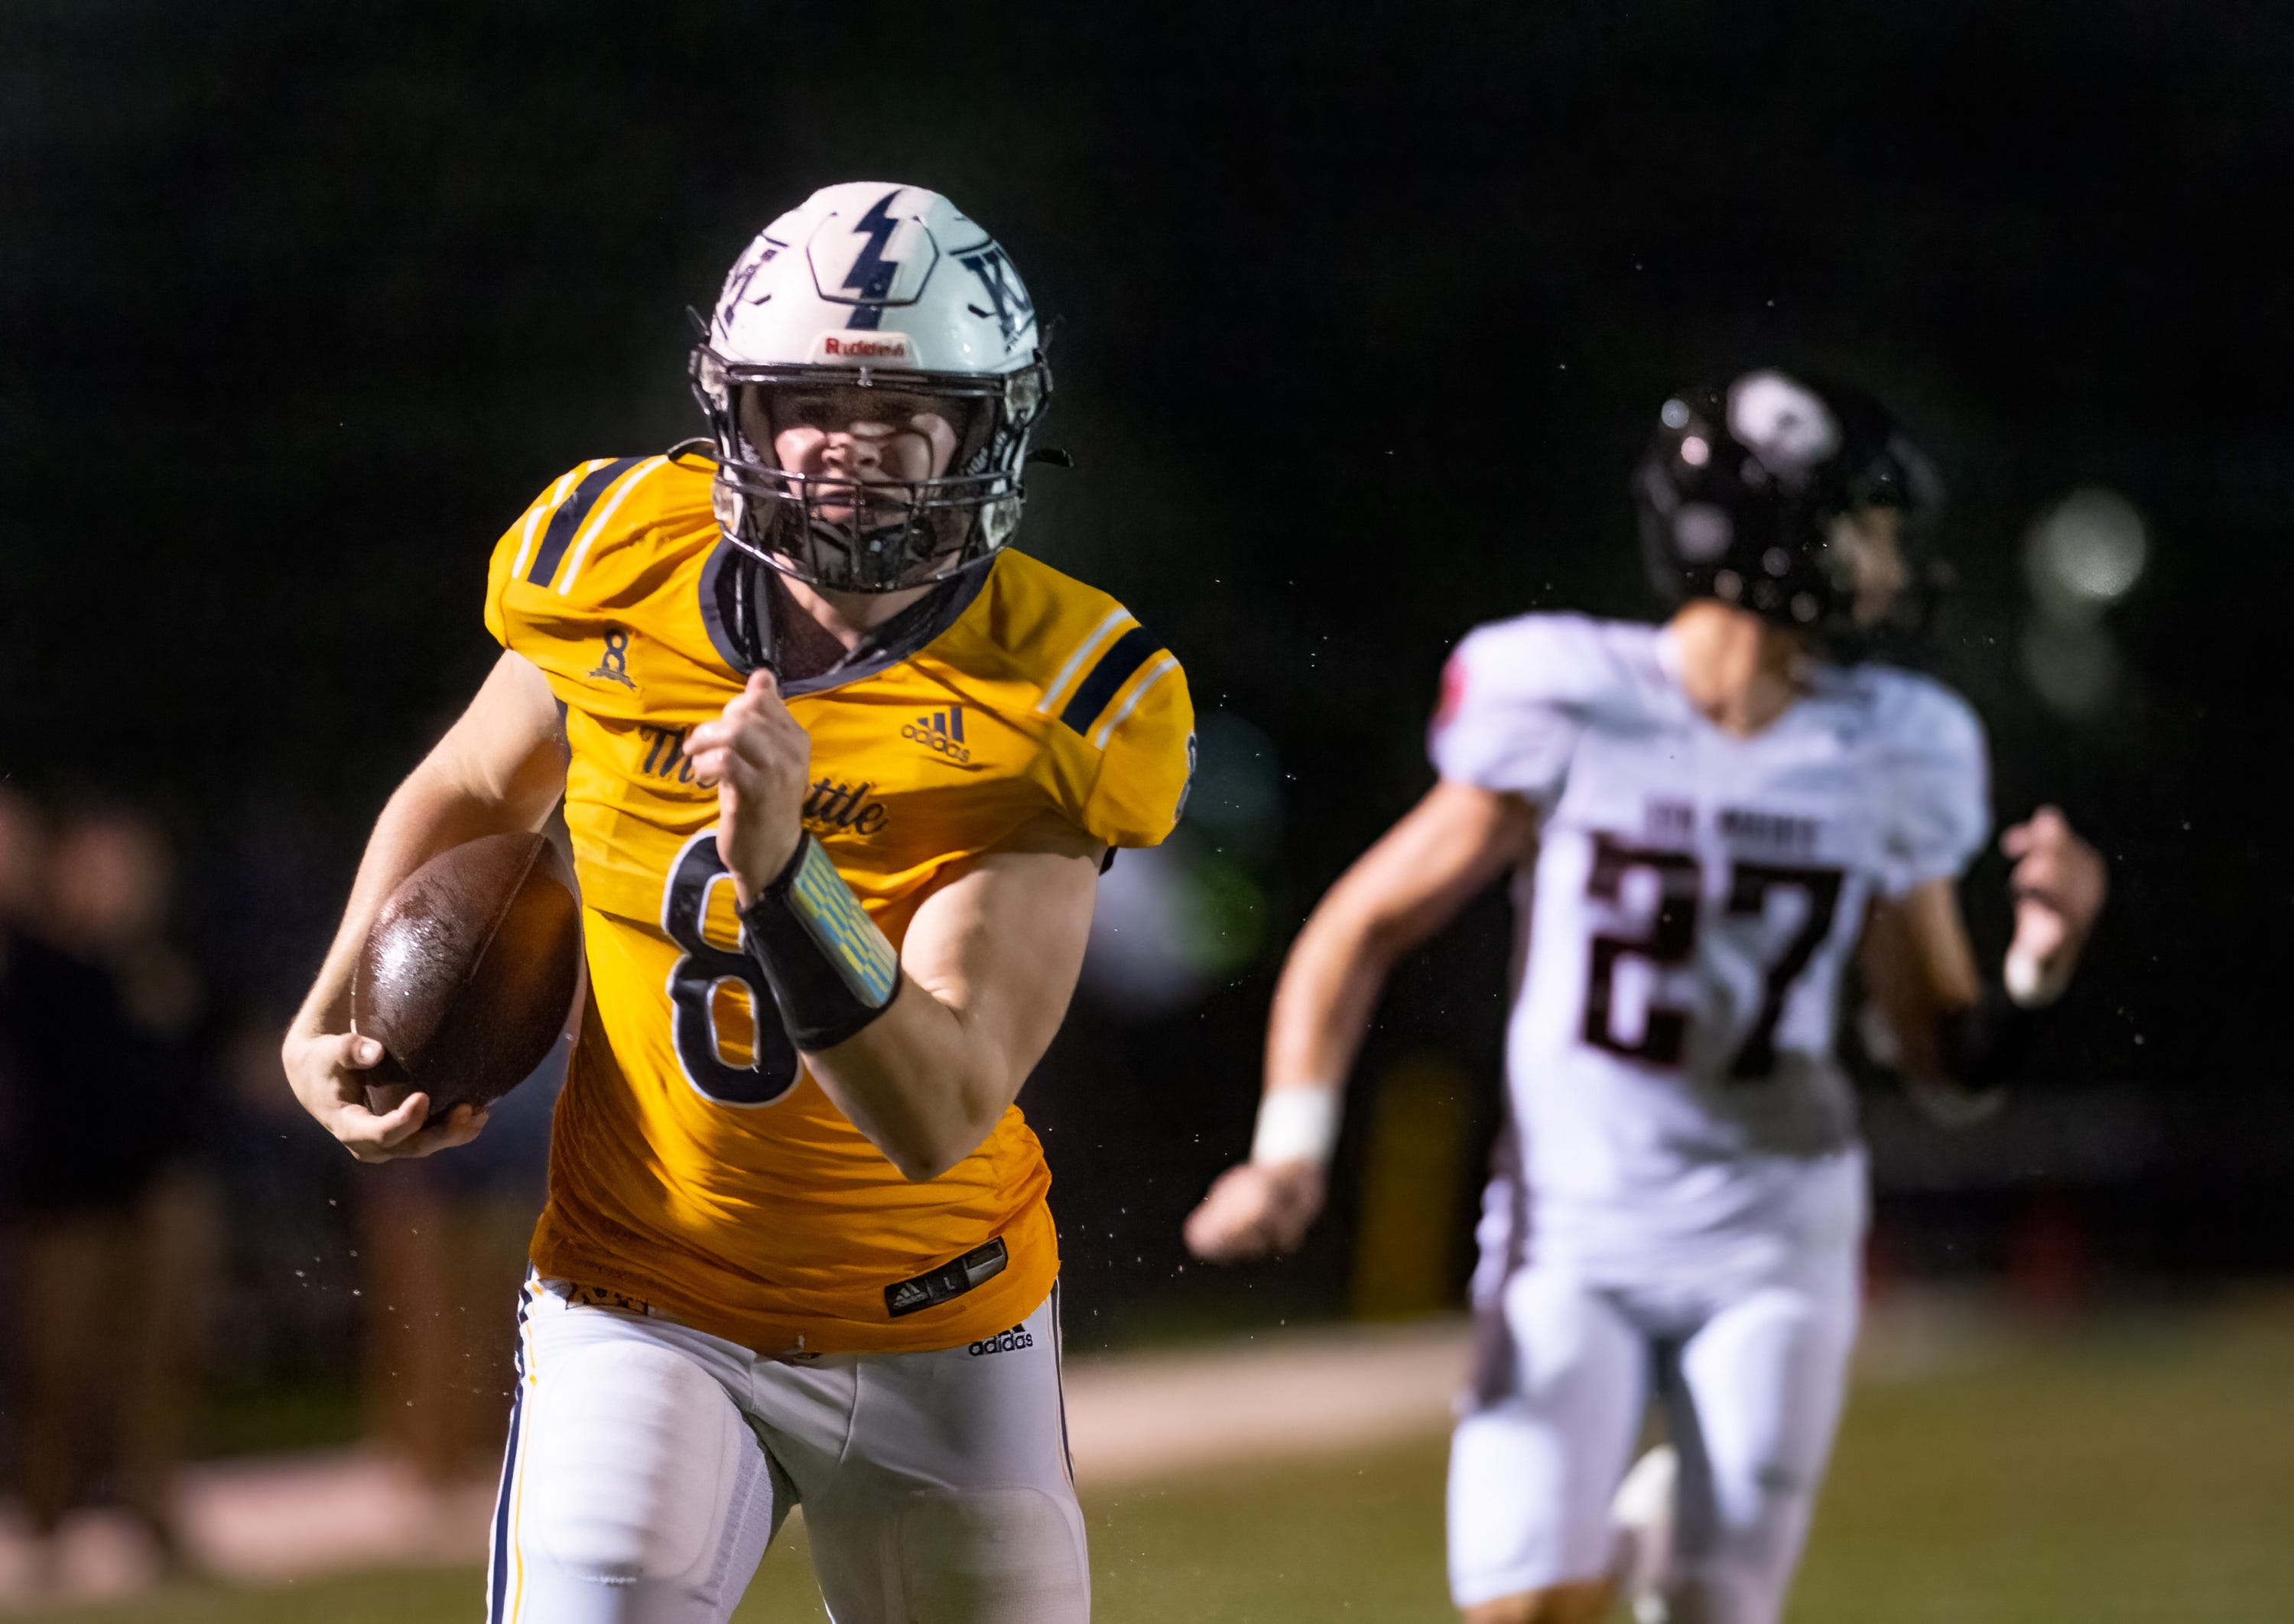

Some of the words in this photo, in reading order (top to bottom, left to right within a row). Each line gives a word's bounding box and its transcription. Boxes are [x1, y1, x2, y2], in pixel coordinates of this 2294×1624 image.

[601, 628, 629, 673] 8
[902, 723, 970, 764] adidas
[801, 777, 889, 836] ttle
[661, 828, 803, 1109] 8
[1580, 830, 1847, 1080] 27
[968, 1332, 1034, 1357] adidas
